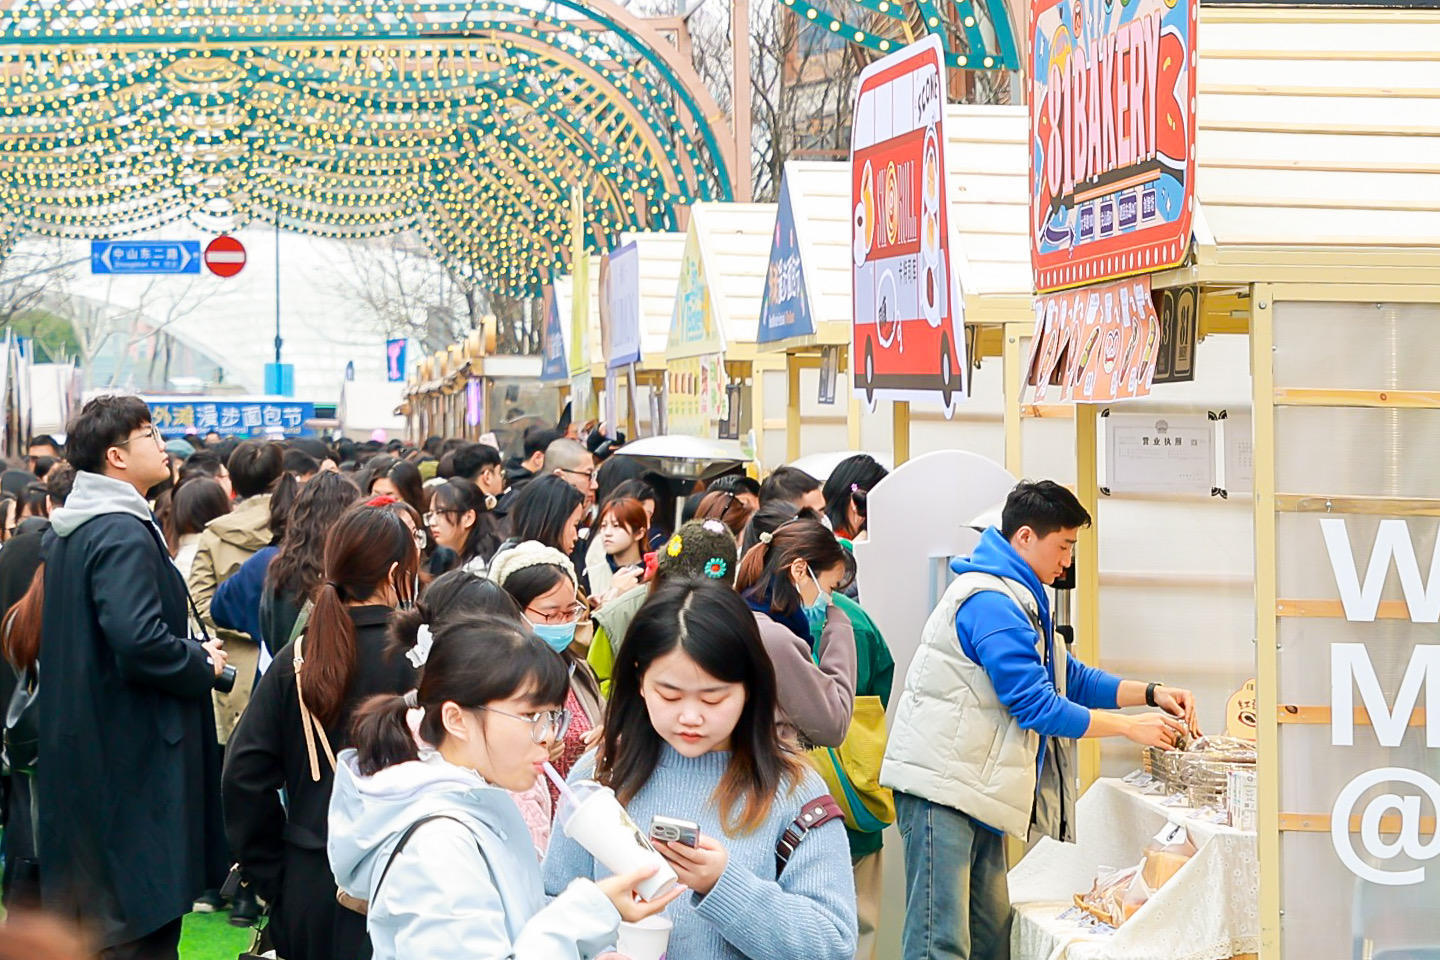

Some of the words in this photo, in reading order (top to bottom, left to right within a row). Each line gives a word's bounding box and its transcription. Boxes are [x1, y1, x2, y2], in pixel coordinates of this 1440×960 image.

[152, 404, 304, 427] 外滩漫步面包节
[1142, 436, 1183, 446] 营业执照
